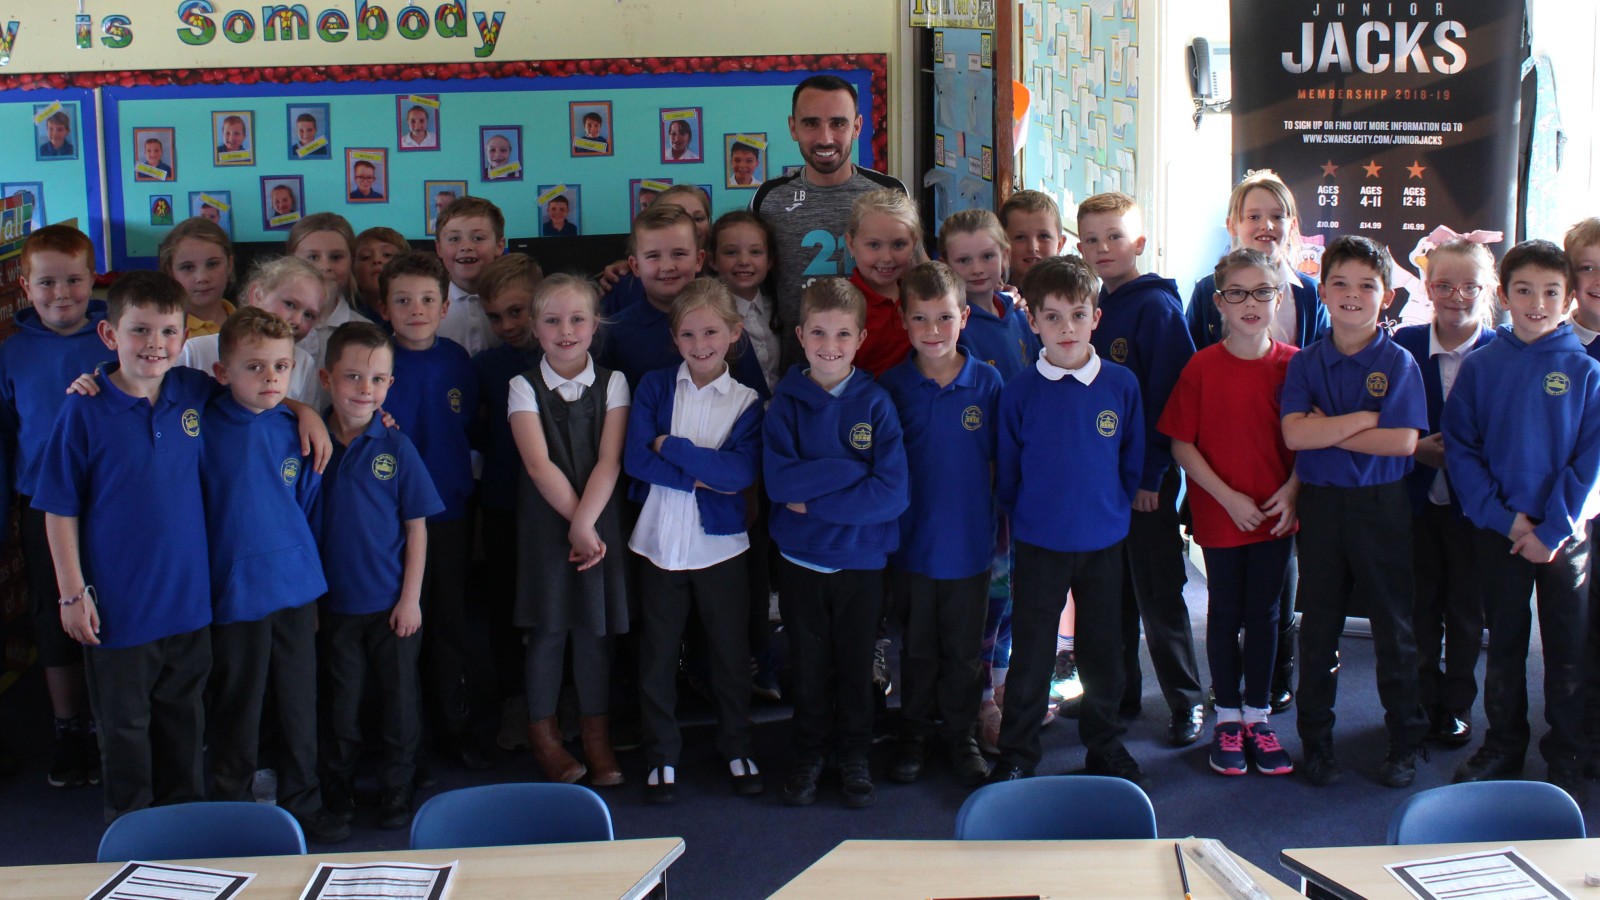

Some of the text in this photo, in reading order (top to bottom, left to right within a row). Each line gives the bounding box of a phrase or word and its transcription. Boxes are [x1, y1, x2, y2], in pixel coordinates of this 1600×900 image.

[1313, 2, 1443, 16] JUNIOR
[75, 14, 133, 48] is
[177, 0, 505, 57] Somebody
[1281, 21, 1467, 75] JACKS
[1297, 89, 1451, 101] MEMBERSHIP 2018-19
[1284, 120, 1463, 132] TO SIGN UP OR FIND OUT MORE INFORMATION GO TO
[1303, 134, 1443, 146] WWW.SWANSEACITY.COM/JUNIORJACKS
[1317, 185, 1339, 194] AGES
[1360, 186, 1382, 195] AGES
[1403, 187, 1426, 196] AGES
[794, 190, 806, 202] LB
[1318, 195, 1339, 206] 0-3
[1360, 195, 1382, 207] 4-11
[1402, 196, 1427, 207] 12-16
[0, 207, 24, 241] all
[1316, 221, 1339, 229] £10.00
[1359, 221, 1382, 229] £14.99
[1402, 223, 1426, 231] £16.99
